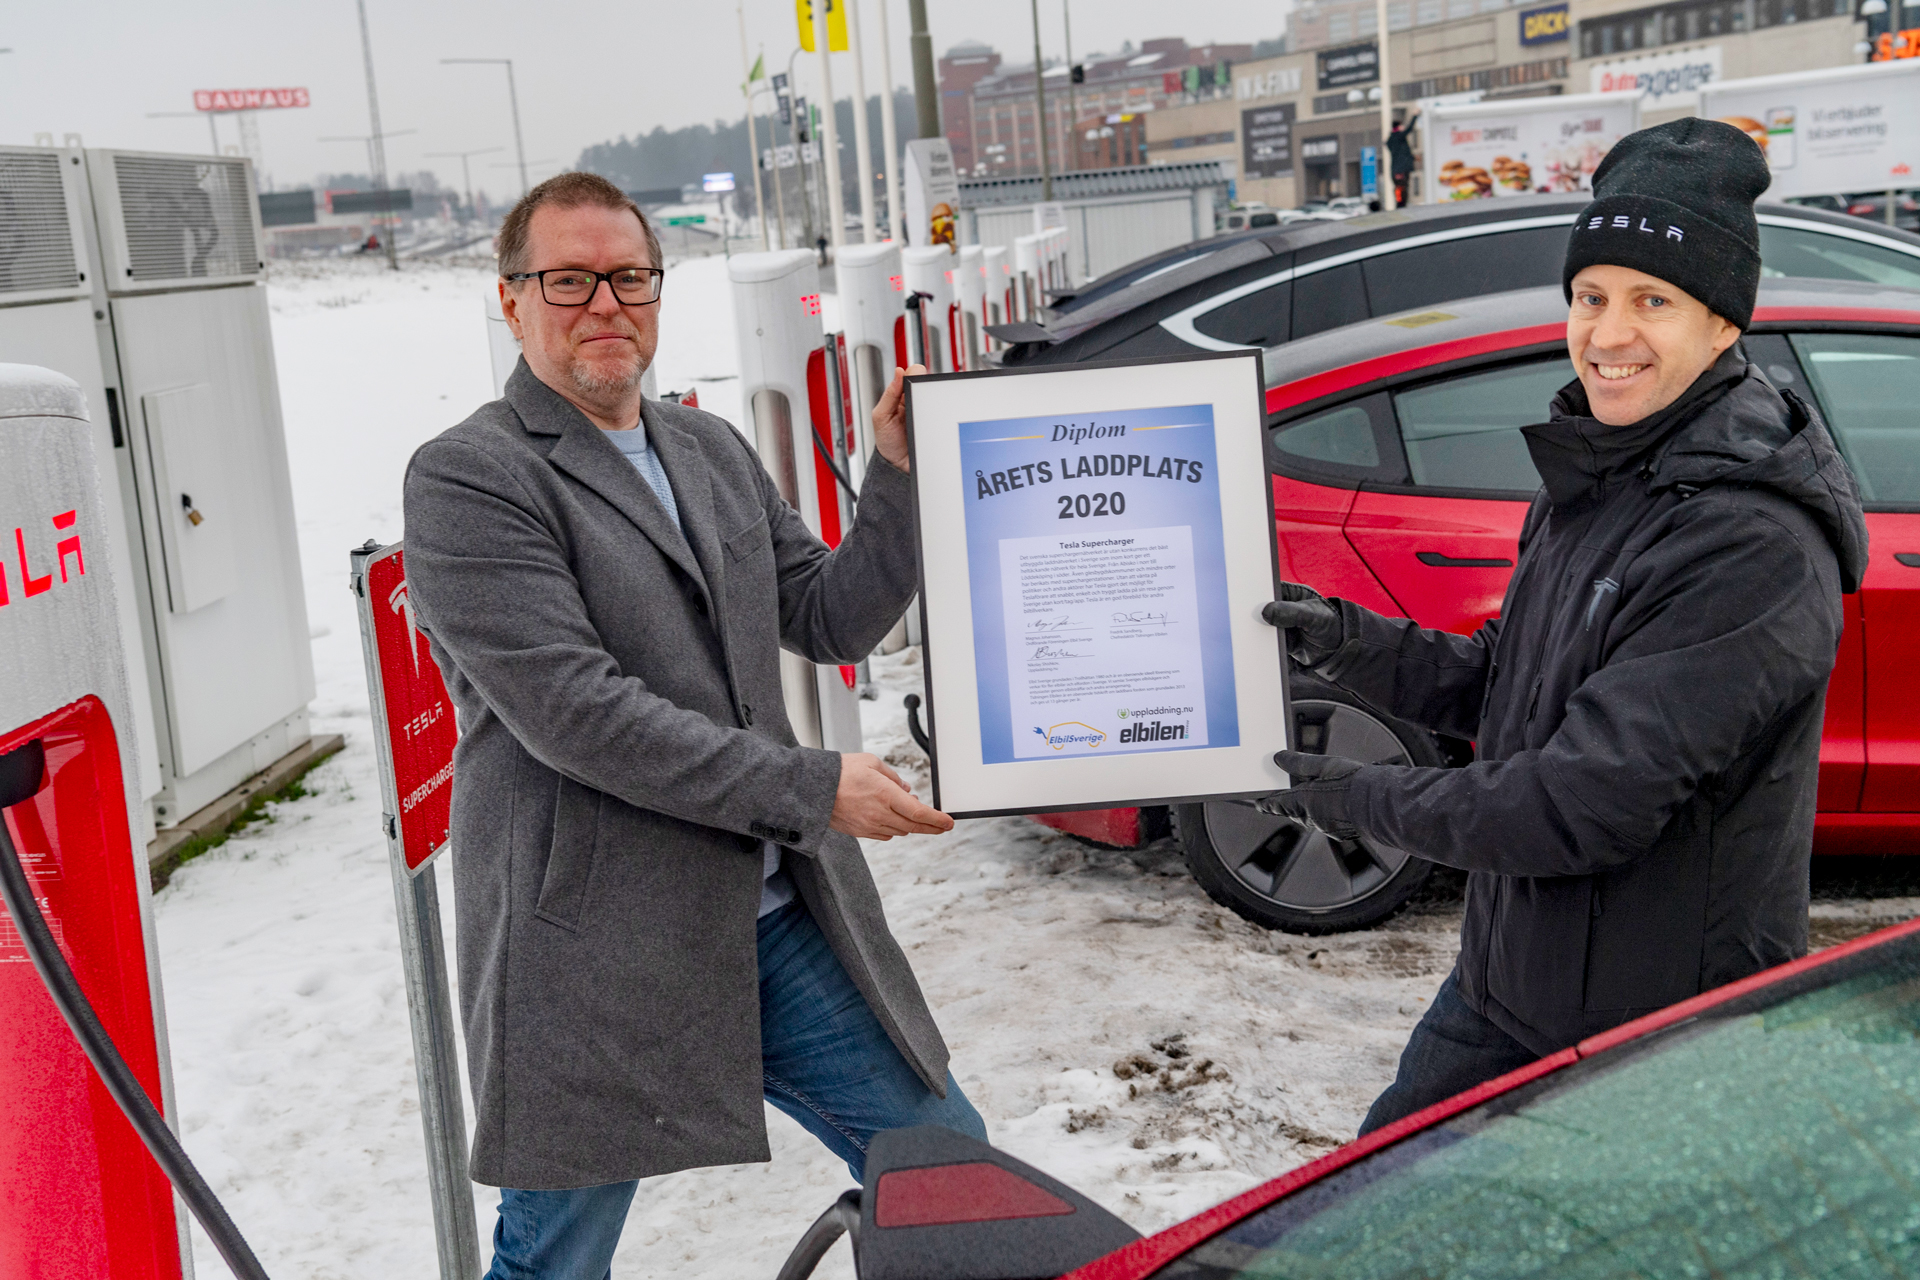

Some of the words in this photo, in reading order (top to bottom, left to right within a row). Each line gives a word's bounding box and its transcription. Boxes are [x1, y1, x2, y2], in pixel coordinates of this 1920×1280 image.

[194, 88, 309, 111] BAUHAUS
[1575, 215, 1684, 242] ESLA
[1050, 422, 1126, 445] Diplom
[975, 460, 1053, 500] ÅRETS
[1060, 454, 1204, 484] LADDPLATS
[1058, 491, 1126, 519] 2020
[1081, 537, 1134, 548] Supercharger
[0, 509, 85, 607] LA
[403, 701, 443, 740] TESLA
[1131, 706, 1193, 718] uppladdning.nu
[1049, 733, 1103, 744] ElbilSverige
[1119, 721, 1185, 743] elbilen
[403, 761, 454, 813] SUPERCHARGE
